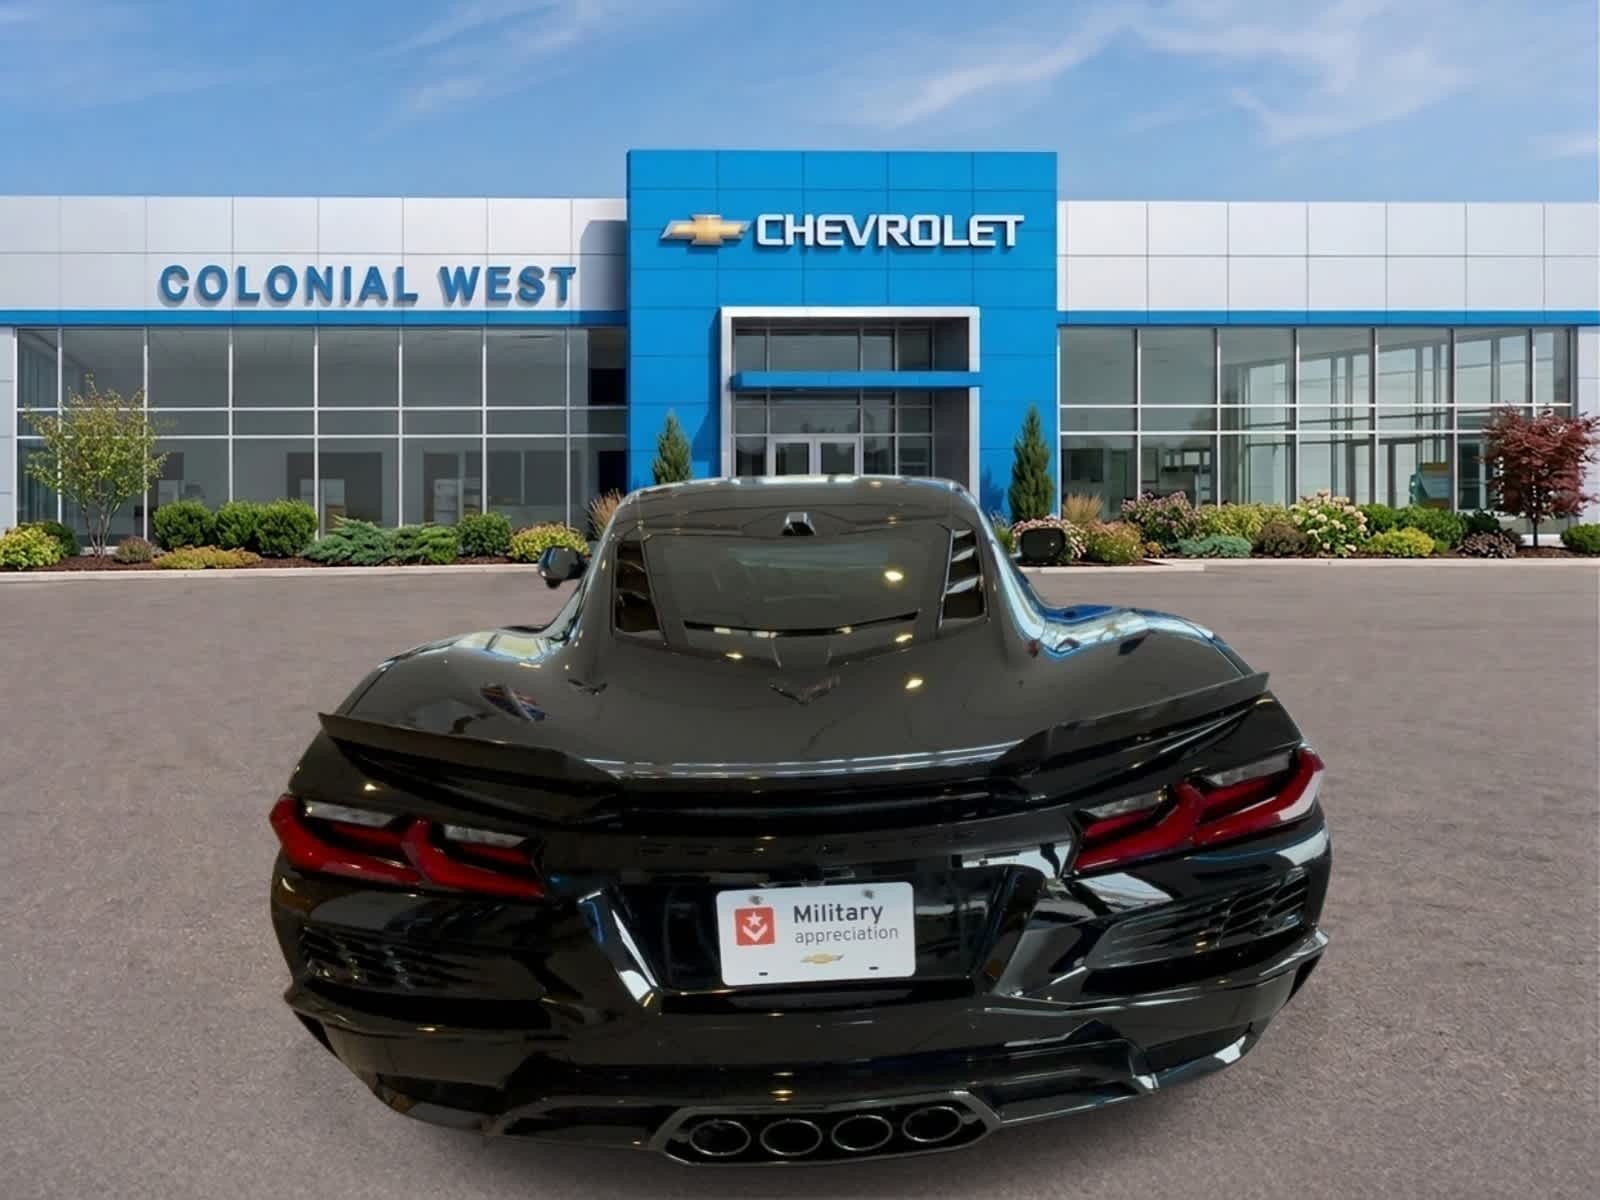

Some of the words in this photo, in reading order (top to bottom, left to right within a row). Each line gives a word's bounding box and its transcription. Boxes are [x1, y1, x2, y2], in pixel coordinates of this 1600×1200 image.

[756, 214, 1025, 247] CHEVROLET
[160, 264, 418, 305] COLONIAL
[439, 265, 577, 305] WEST
[793, 903, 884, 925] Military
[795, 926, 899, 945] appreciation
